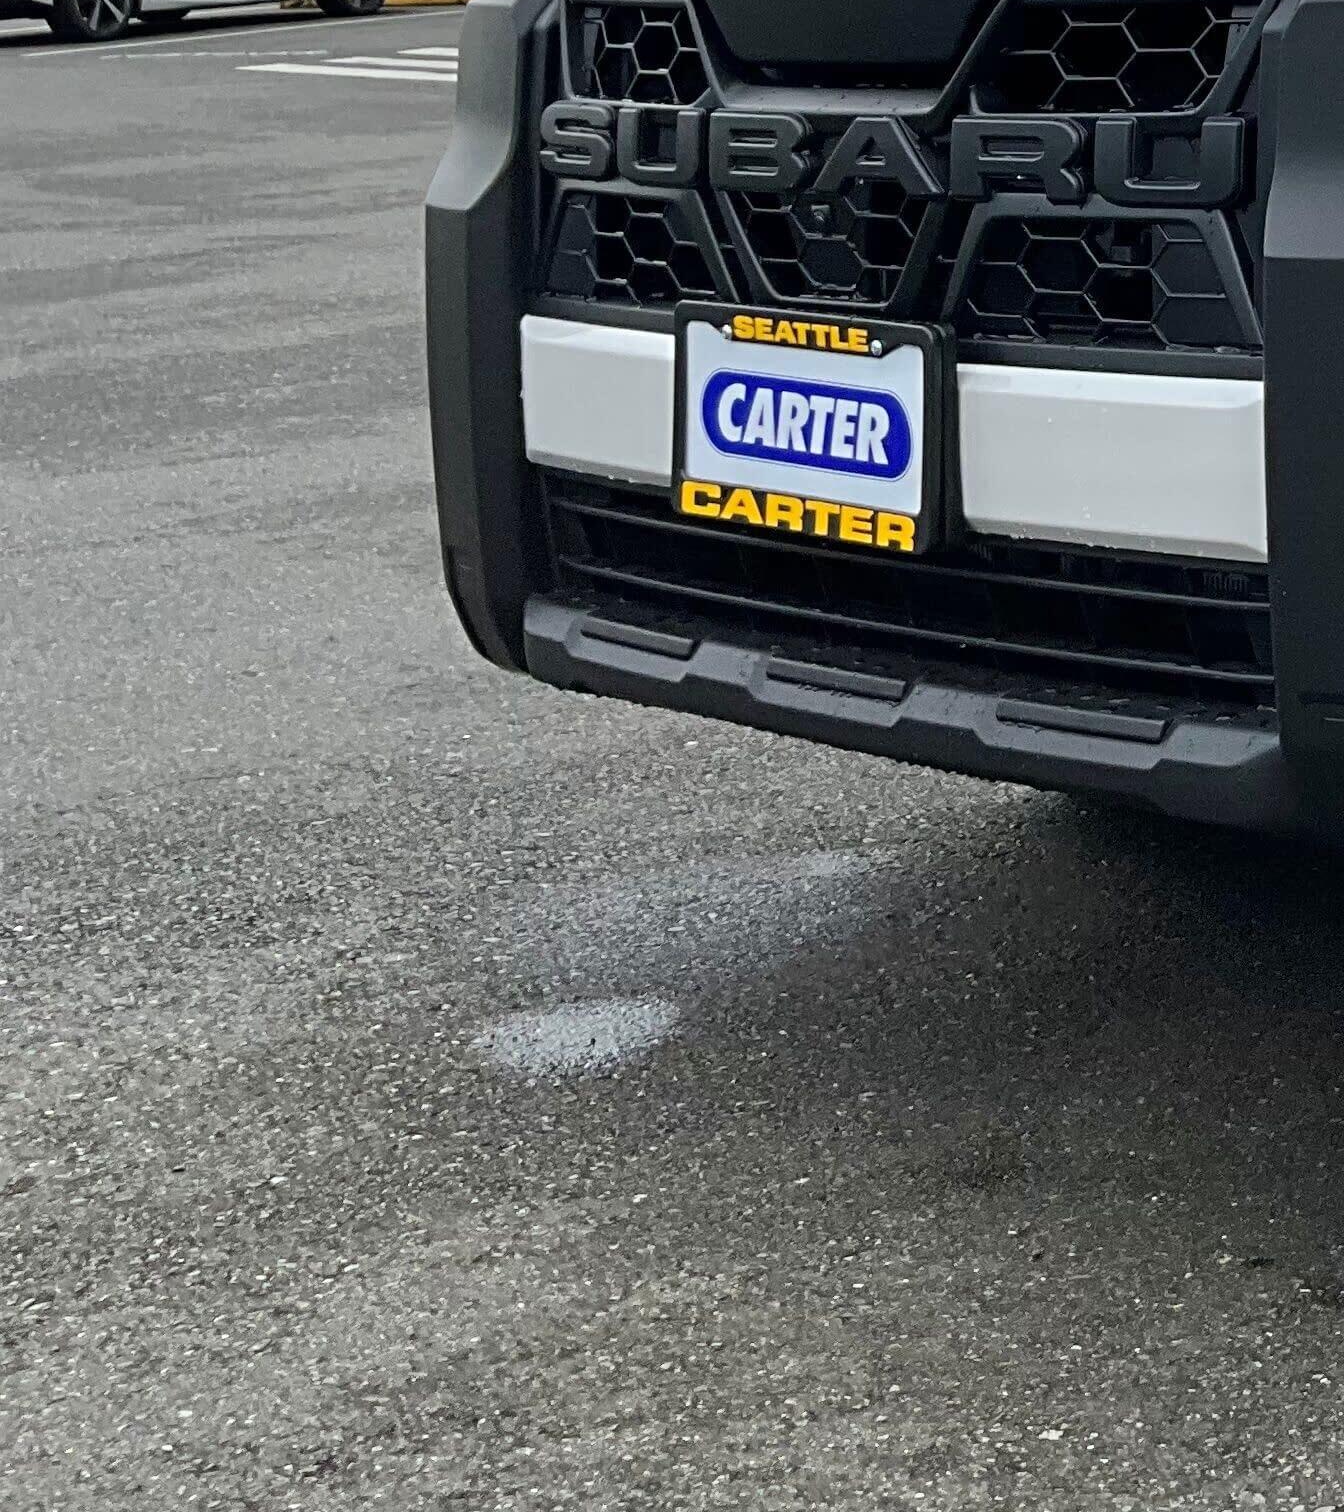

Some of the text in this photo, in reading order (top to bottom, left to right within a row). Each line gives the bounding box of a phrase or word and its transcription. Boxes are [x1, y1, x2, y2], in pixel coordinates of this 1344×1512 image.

[539, 102, 1248, 208] SUBARU
[732, 314, 869, 353] SEATTLE
[718, 382, 889, 465] CARTER
[681, 480, 915, 552] CARTER
